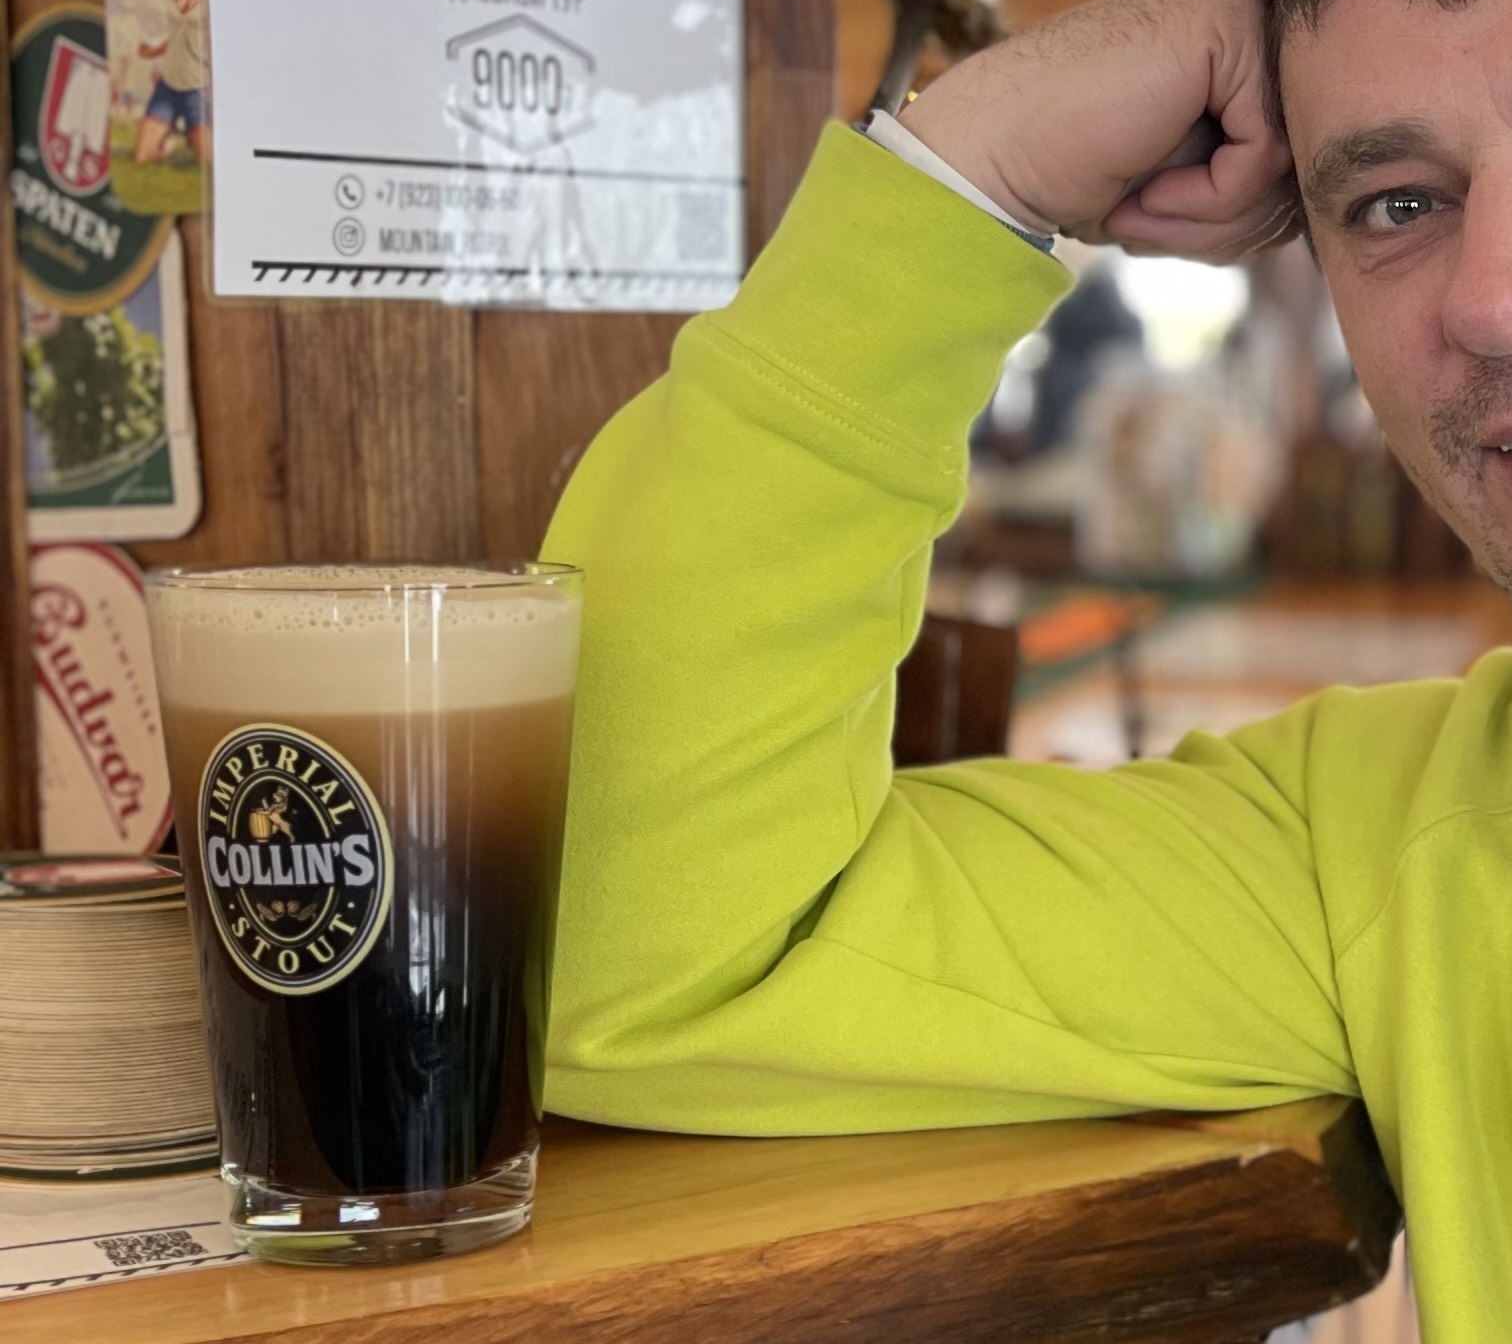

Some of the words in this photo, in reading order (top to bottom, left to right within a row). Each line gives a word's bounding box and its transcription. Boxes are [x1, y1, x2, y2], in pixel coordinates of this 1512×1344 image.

[10, 168, 122, 261] SPATEN
[208, 743, 356, 827] IMPERIAL
[207, 833, 376, 888] COLLIN'S
[230, 912, 356, 975] STOUT
